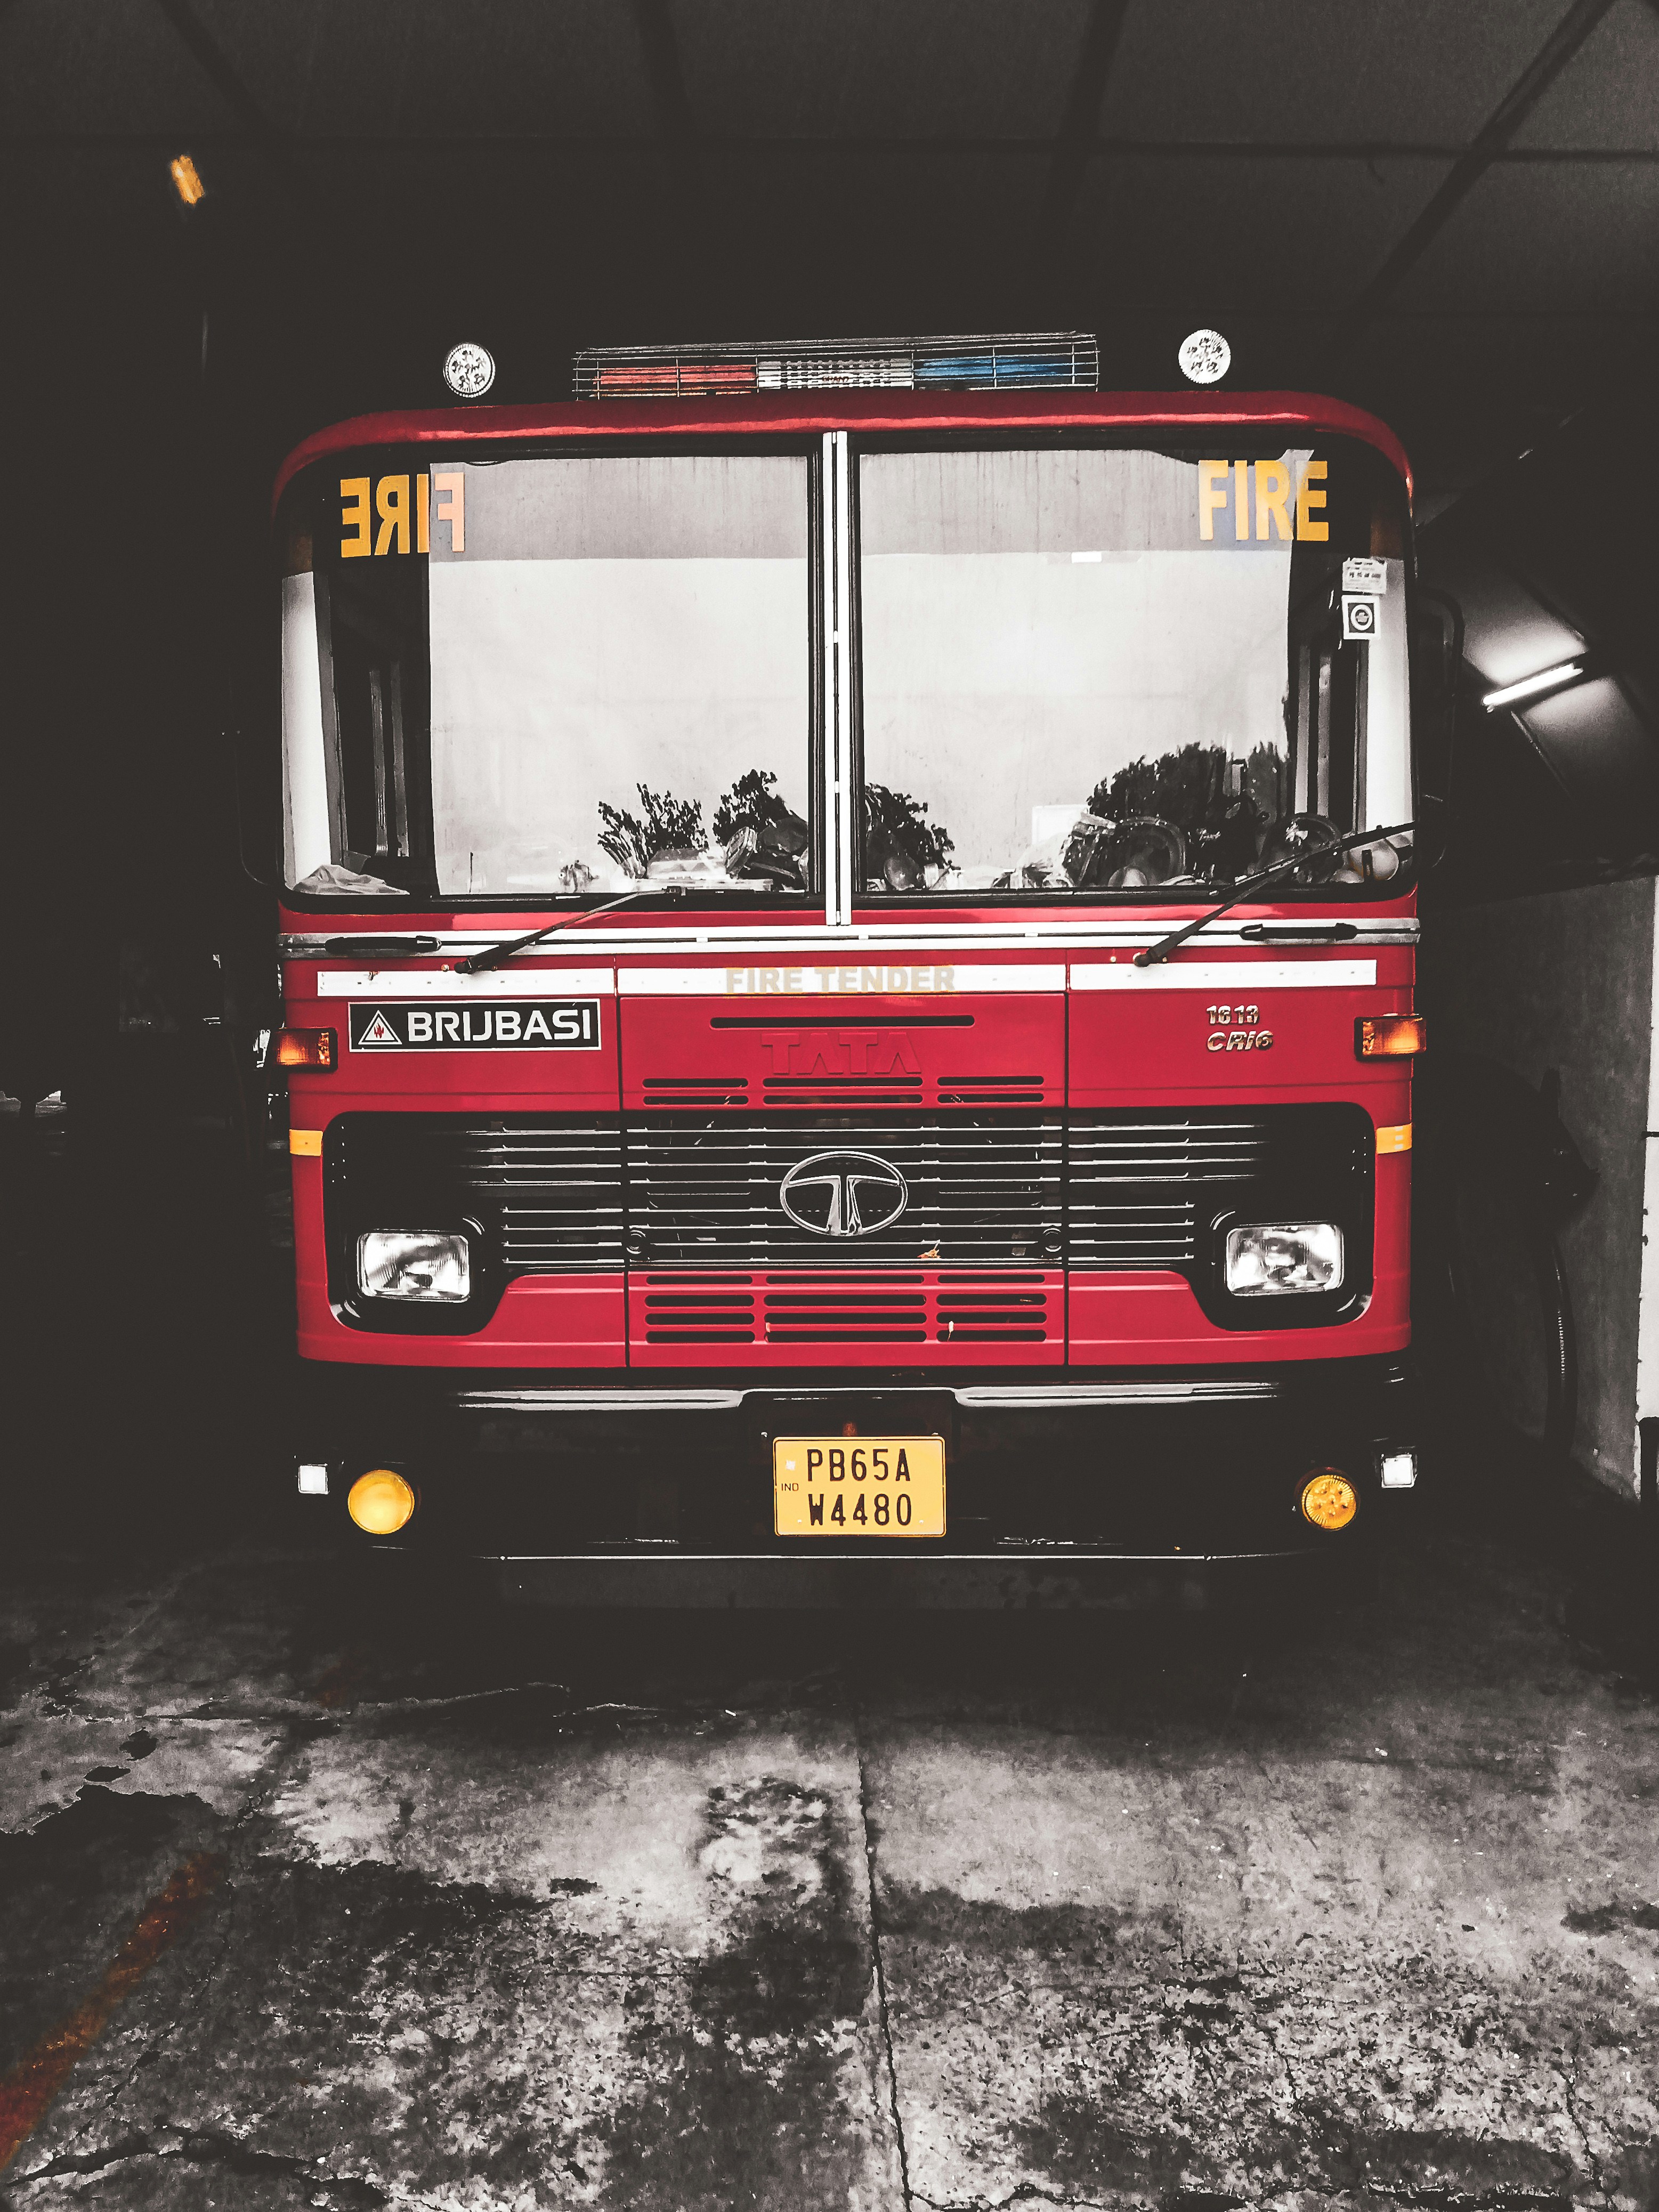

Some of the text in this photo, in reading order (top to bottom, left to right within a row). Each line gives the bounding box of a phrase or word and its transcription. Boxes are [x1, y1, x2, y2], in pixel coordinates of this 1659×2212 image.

[1198, 459, 1329, 541] FIRE
[726, 966, 954, 992] FIRE TENDER
[407, 1009, 590, 1041] BRIJBASI
[1206, 1005, 1259, 1024] 1613
[760, 1032, 921, 1075] TATA
[807, 1448, 911, 1482] PB65A
[781, 1483, 799, 1492] IND
[808, 1493, 912, 1526] W4480
